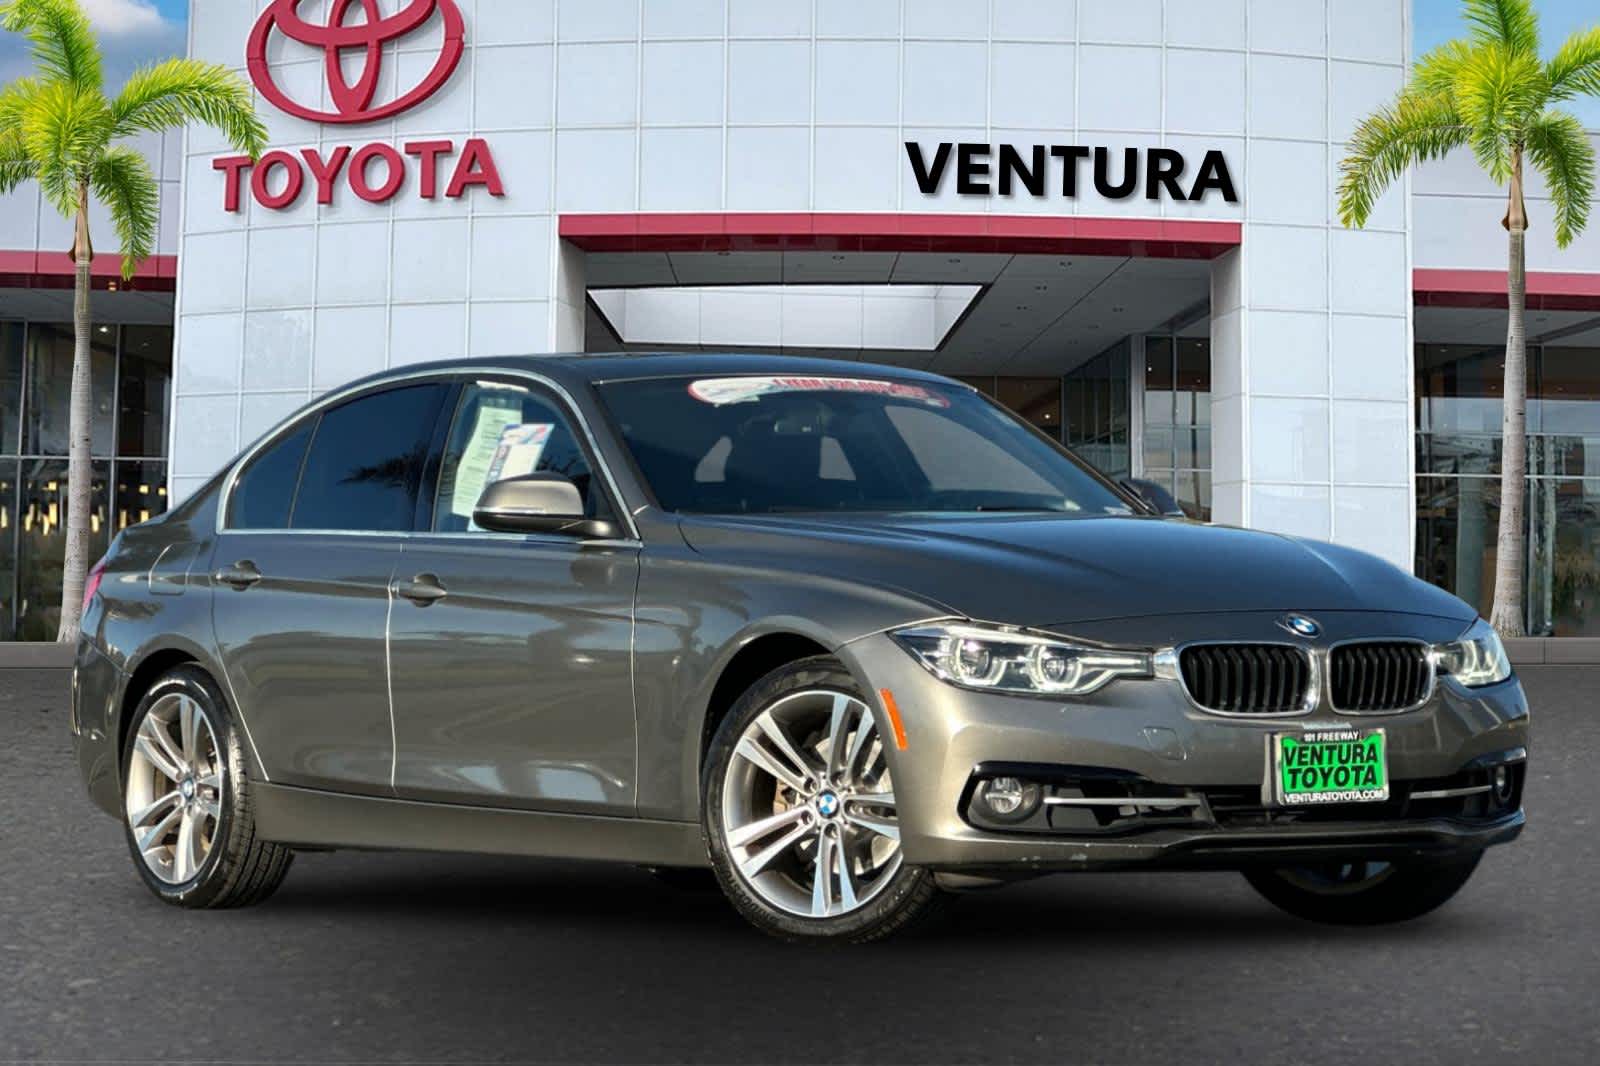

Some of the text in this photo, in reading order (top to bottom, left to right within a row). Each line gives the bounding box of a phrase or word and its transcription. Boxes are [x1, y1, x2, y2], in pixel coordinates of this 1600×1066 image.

[212, 138, 505, 212] TOYOTA
[904, 141, 1238, 203] VENTURA
[1317, 731, 1358, 741] FREEWAY
[1283, 743, 1378, 767] VENTURA
[1287, 765, 1377, 789] TOYOTA
[1284, 789, 1384, 803] VENTURATOYOTA.COM
